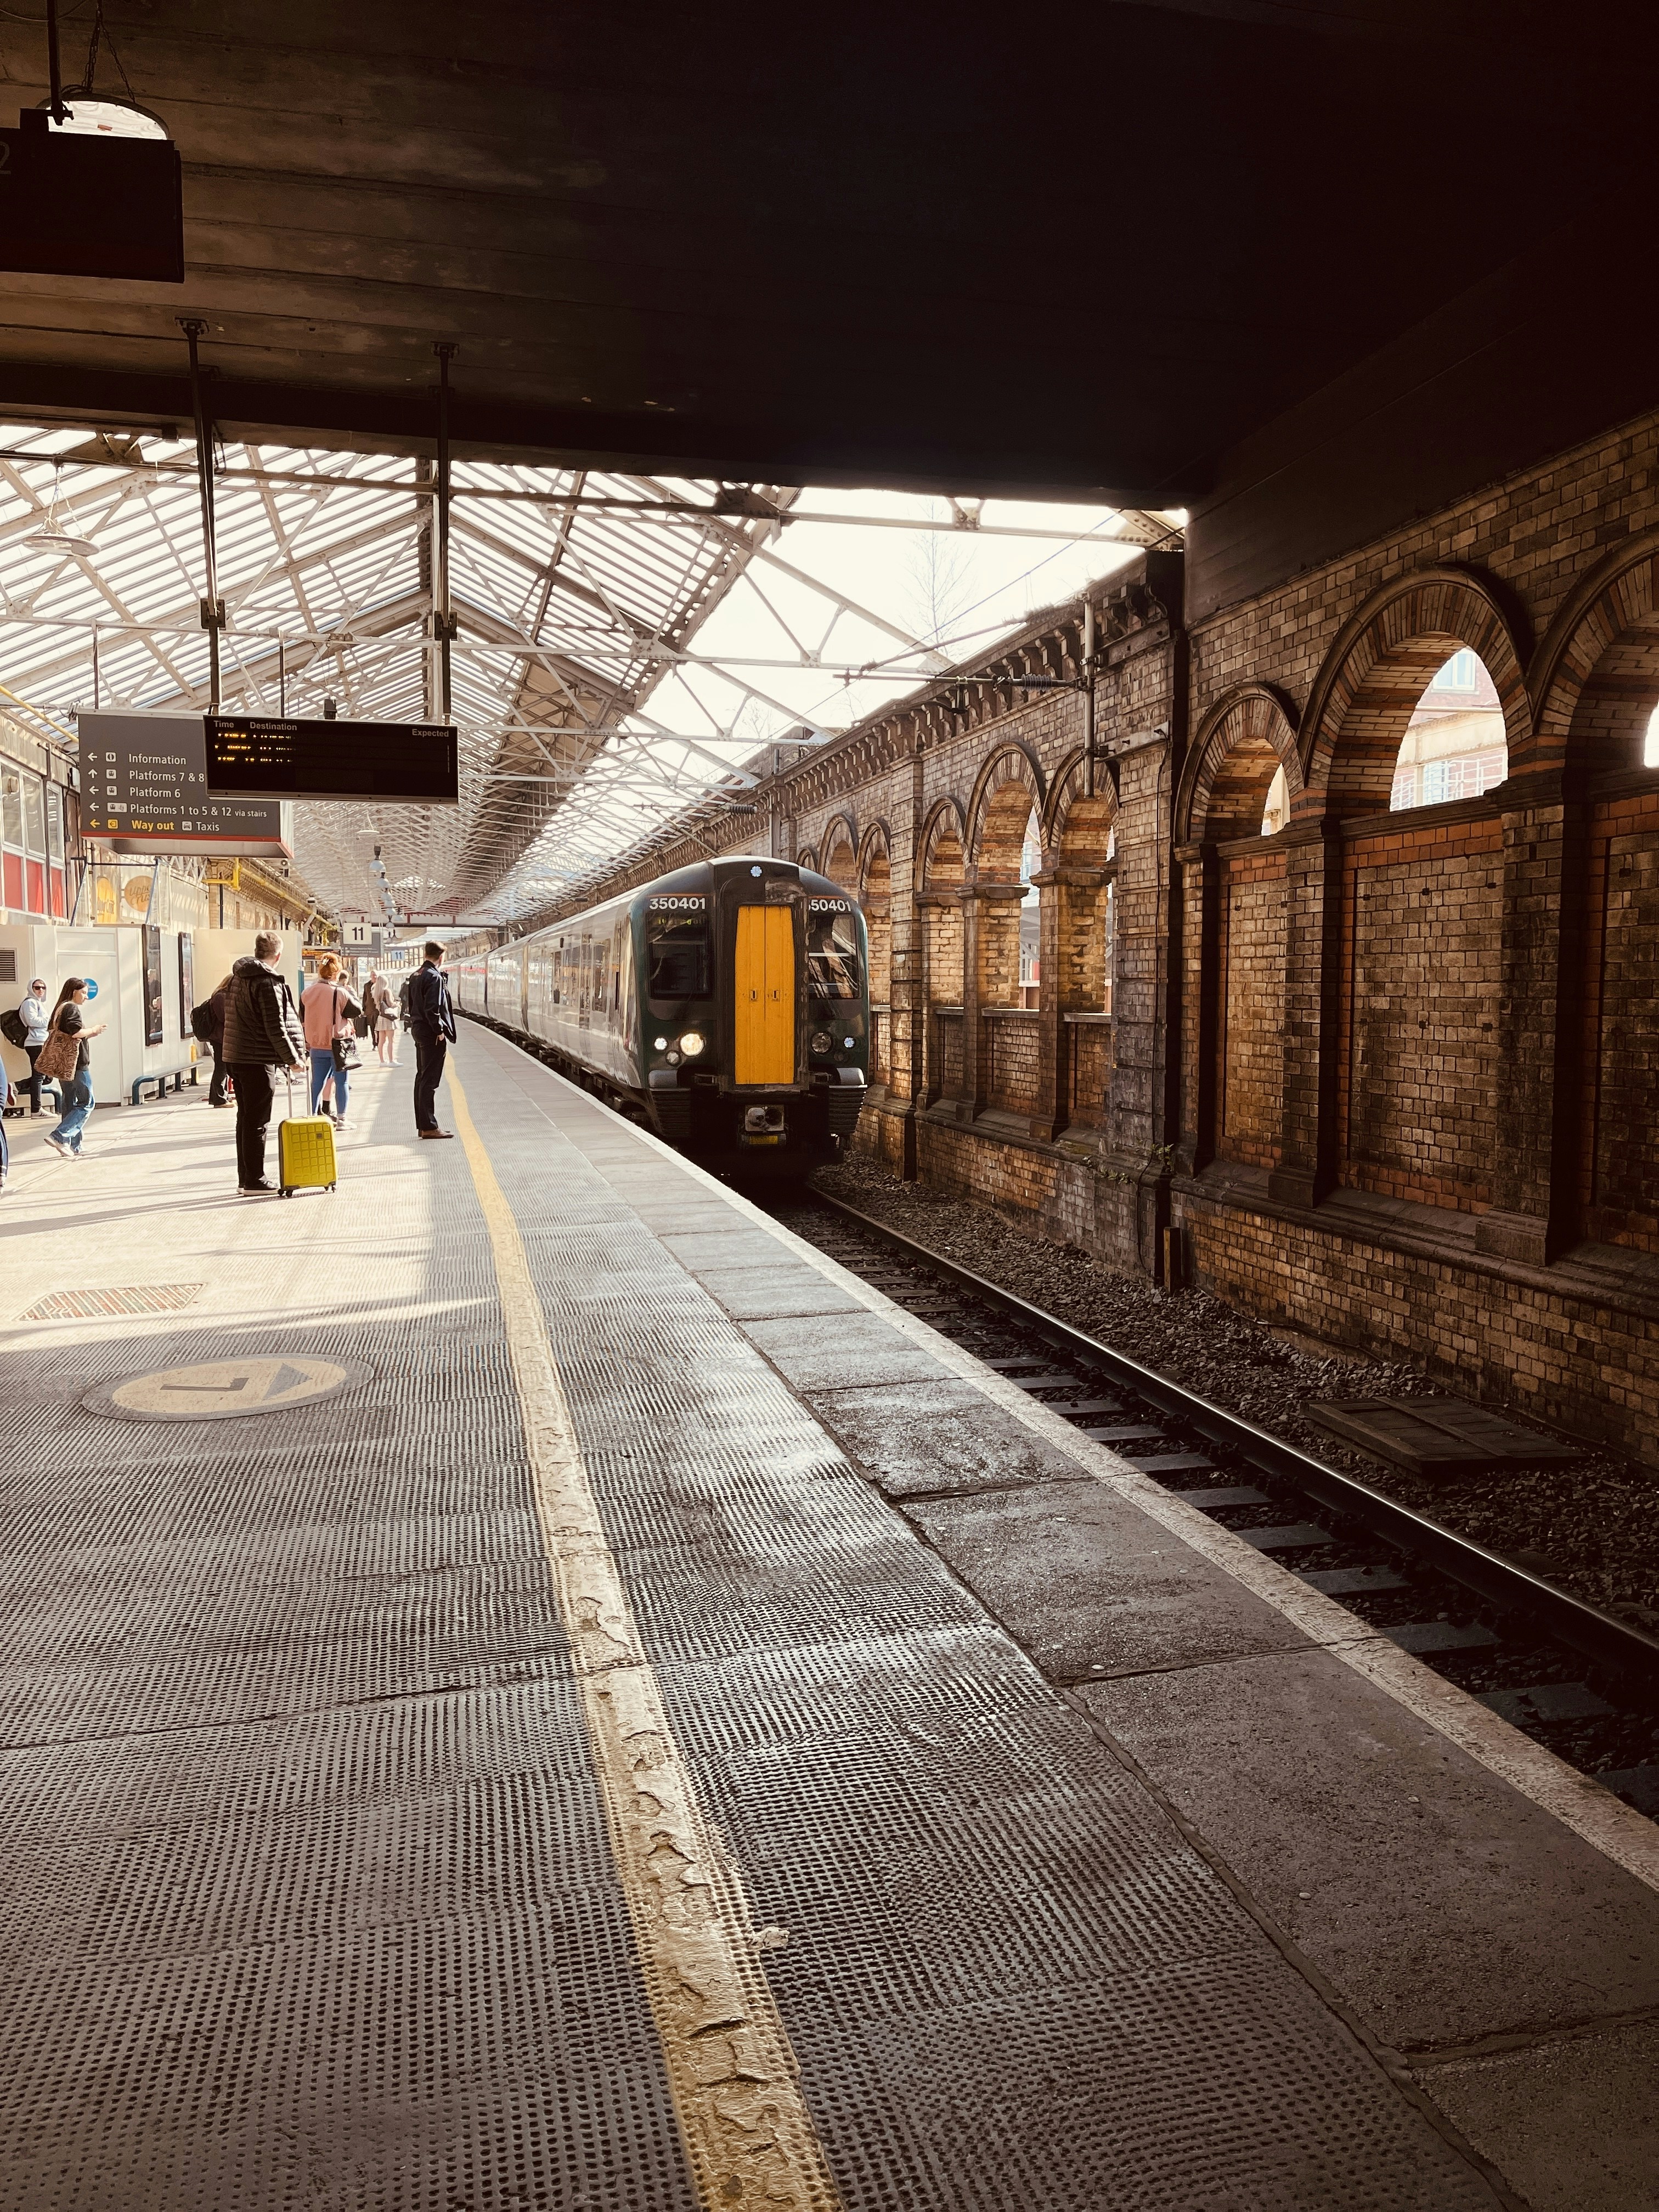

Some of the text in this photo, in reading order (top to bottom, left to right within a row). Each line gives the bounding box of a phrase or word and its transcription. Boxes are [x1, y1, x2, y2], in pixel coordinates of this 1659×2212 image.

[250, 721, 297, 730] Destination
[412, 729, 449, 737] Expected
[128, 753, 186, 765] Information
[129, 770, 205, 782] Platforms 7 & 8
[129, 787, 180, 798] Platform 6
[130, 804, 177, 814] Platforms
[180, 805, 185, 815] 1
[189, 806, 199, 815] to
[202, 806, 207, 815] 5
[211, 806, 218, 816] &
[222, 807, 232, 816] 12
[131, 820, 174, 832] Way out
[196, 821, 219, 831] Taxis
[649, 897, 706, 910] 350401
[352, 927, 363, 940] 11
[394, 951, 402, 960] 11
